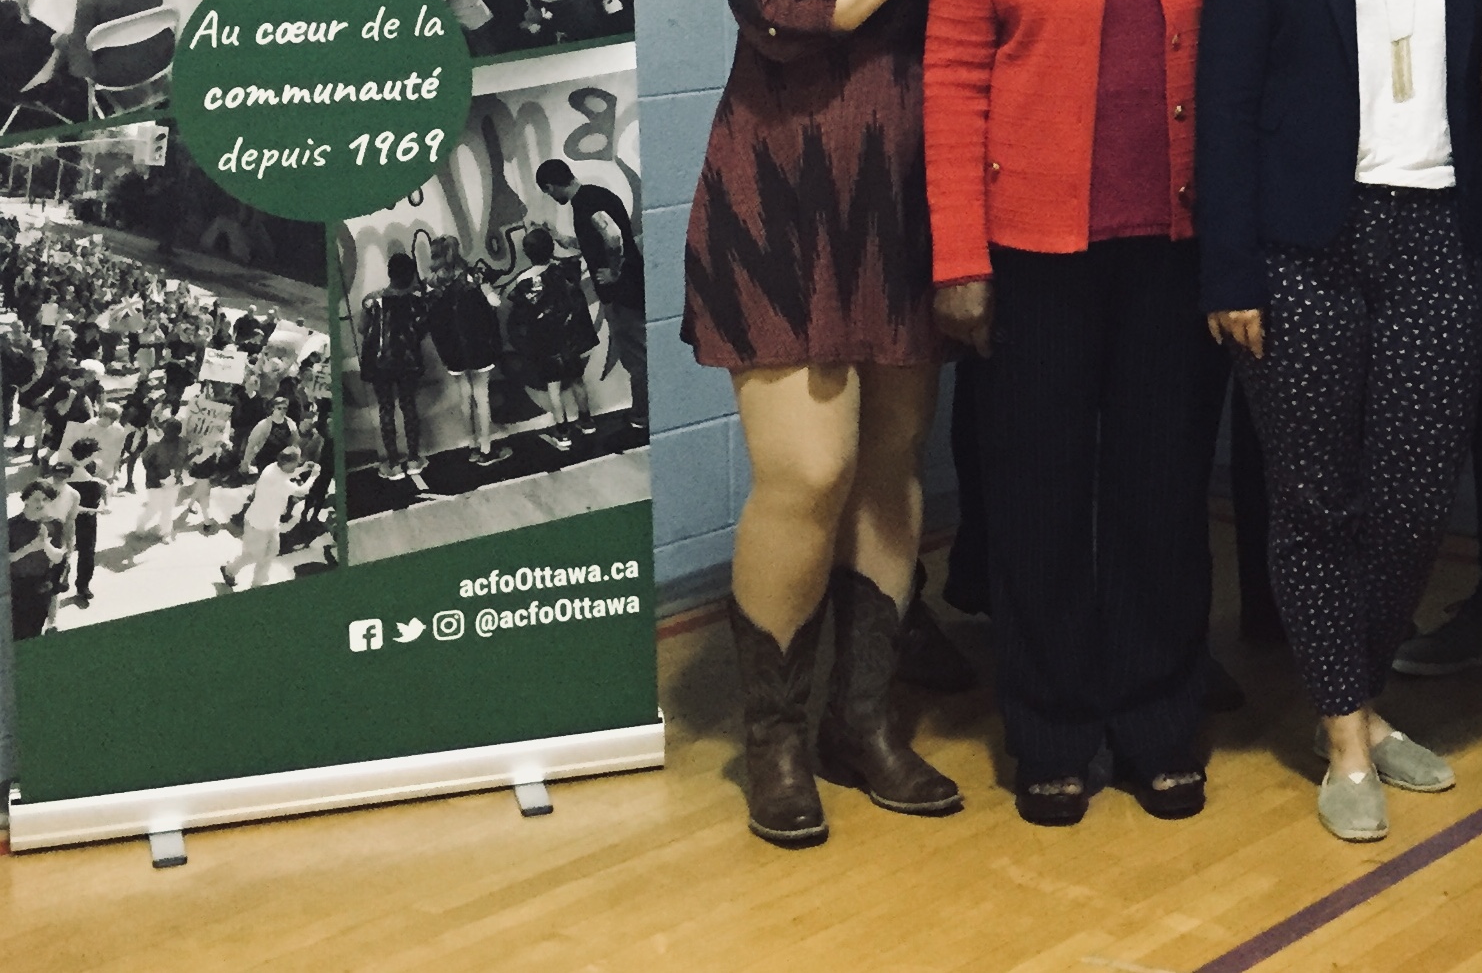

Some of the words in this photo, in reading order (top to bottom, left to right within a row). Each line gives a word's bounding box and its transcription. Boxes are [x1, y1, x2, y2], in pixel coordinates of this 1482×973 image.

[189, 9, 240, 50] Au
[255, 19, 349, 46] cœur
[361, 5, 400, 40] de
[414, 4, 445, 37] la
[203, 66, 443, 111] communauté
[217, 136, 332, 180] depuis
[348, 128, 445, 166] 1969
[459, 560, 640, 598] acfoOttawa.ca
[475, 595, 640, 638] @acfoOttawa
